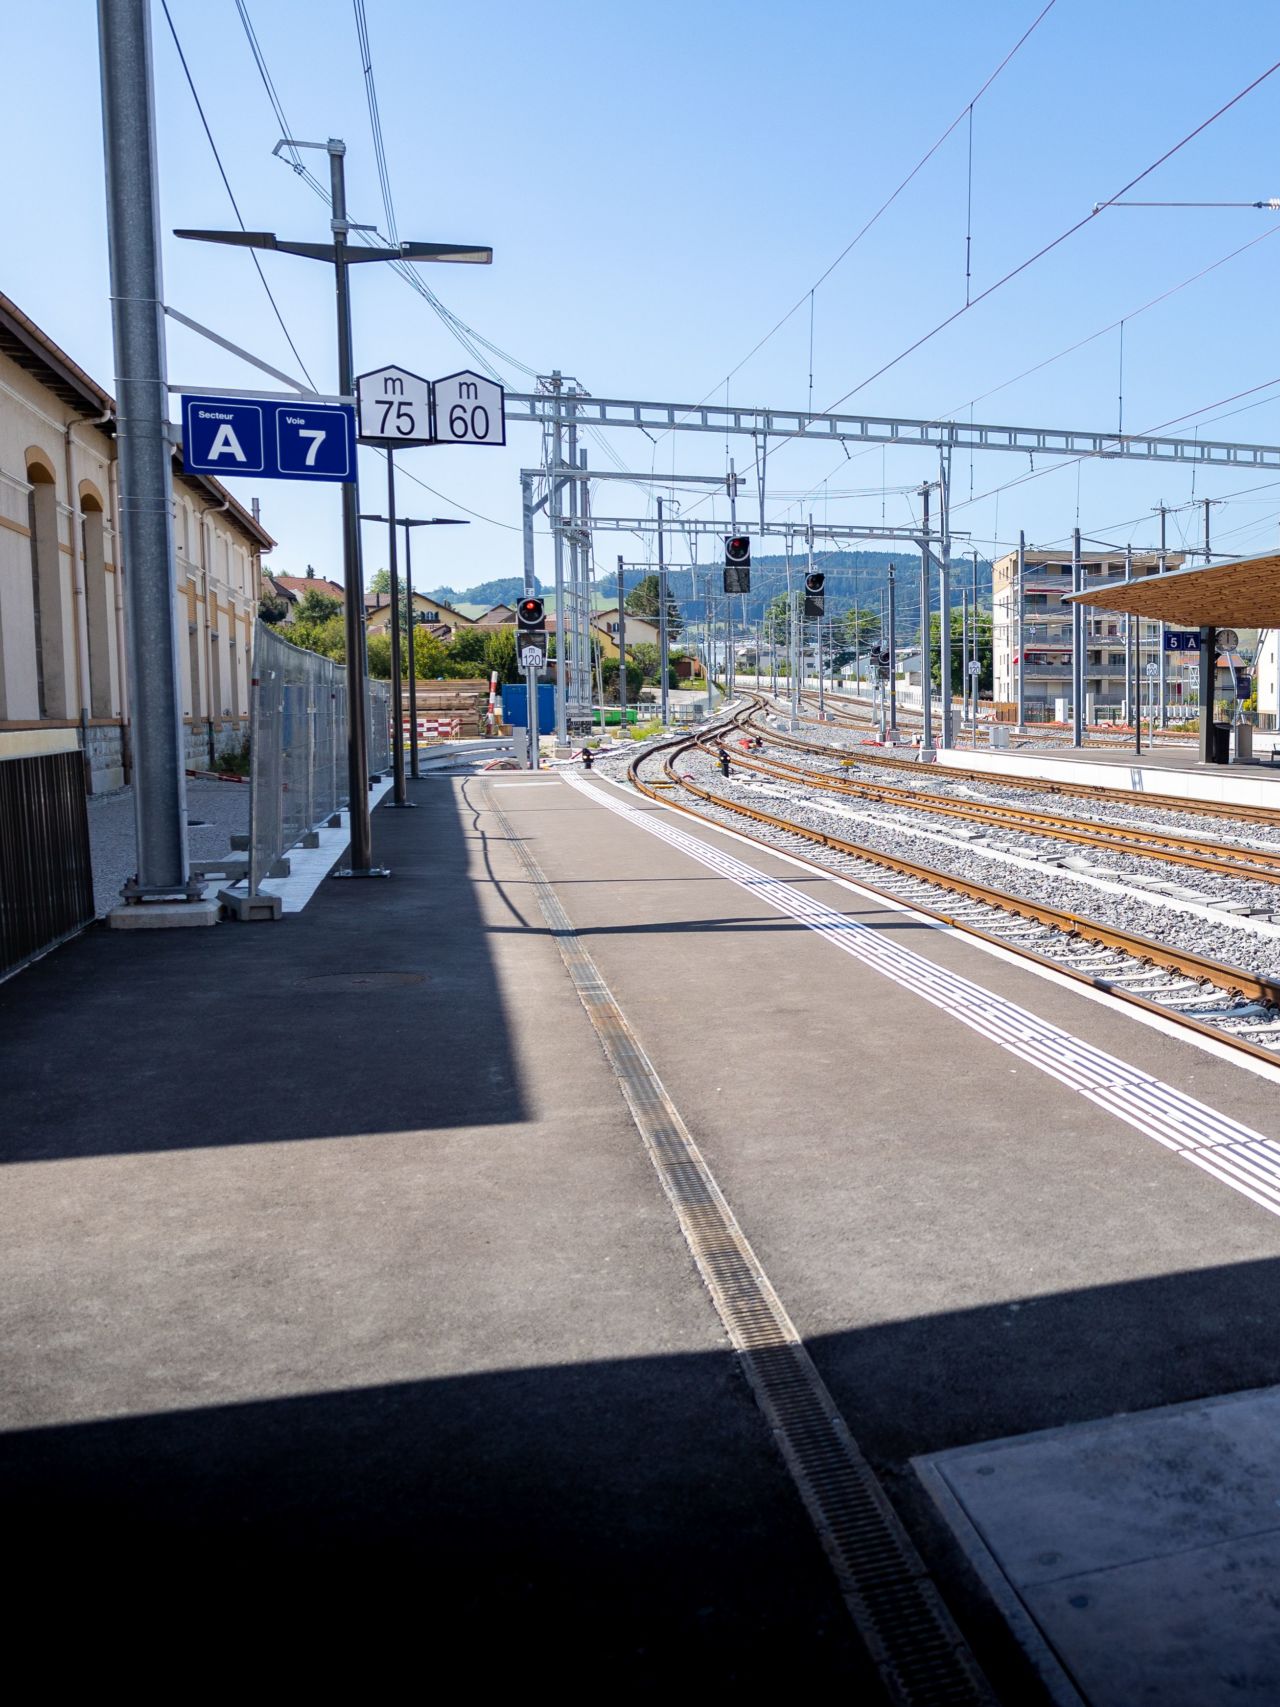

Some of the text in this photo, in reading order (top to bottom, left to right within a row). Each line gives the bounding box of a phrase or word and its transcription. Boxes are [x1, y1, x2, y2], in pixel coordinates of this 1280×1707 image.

[383, 376, 404, 396] m
[458, 381, 478, 400] m
[198, 410, 234, 420] Secteur
[286, 416, 305, 425] Voie
[374, 399, 415, 436] 75
[449, 404, 490, 440] 60
[207, 424, 247, 463] A
[298, 428, 327, 466] 7
[1170, 637, 1178, 648] 5
[1187, 637, 1197, 648] A
[523, 654, 541, 666] 120
